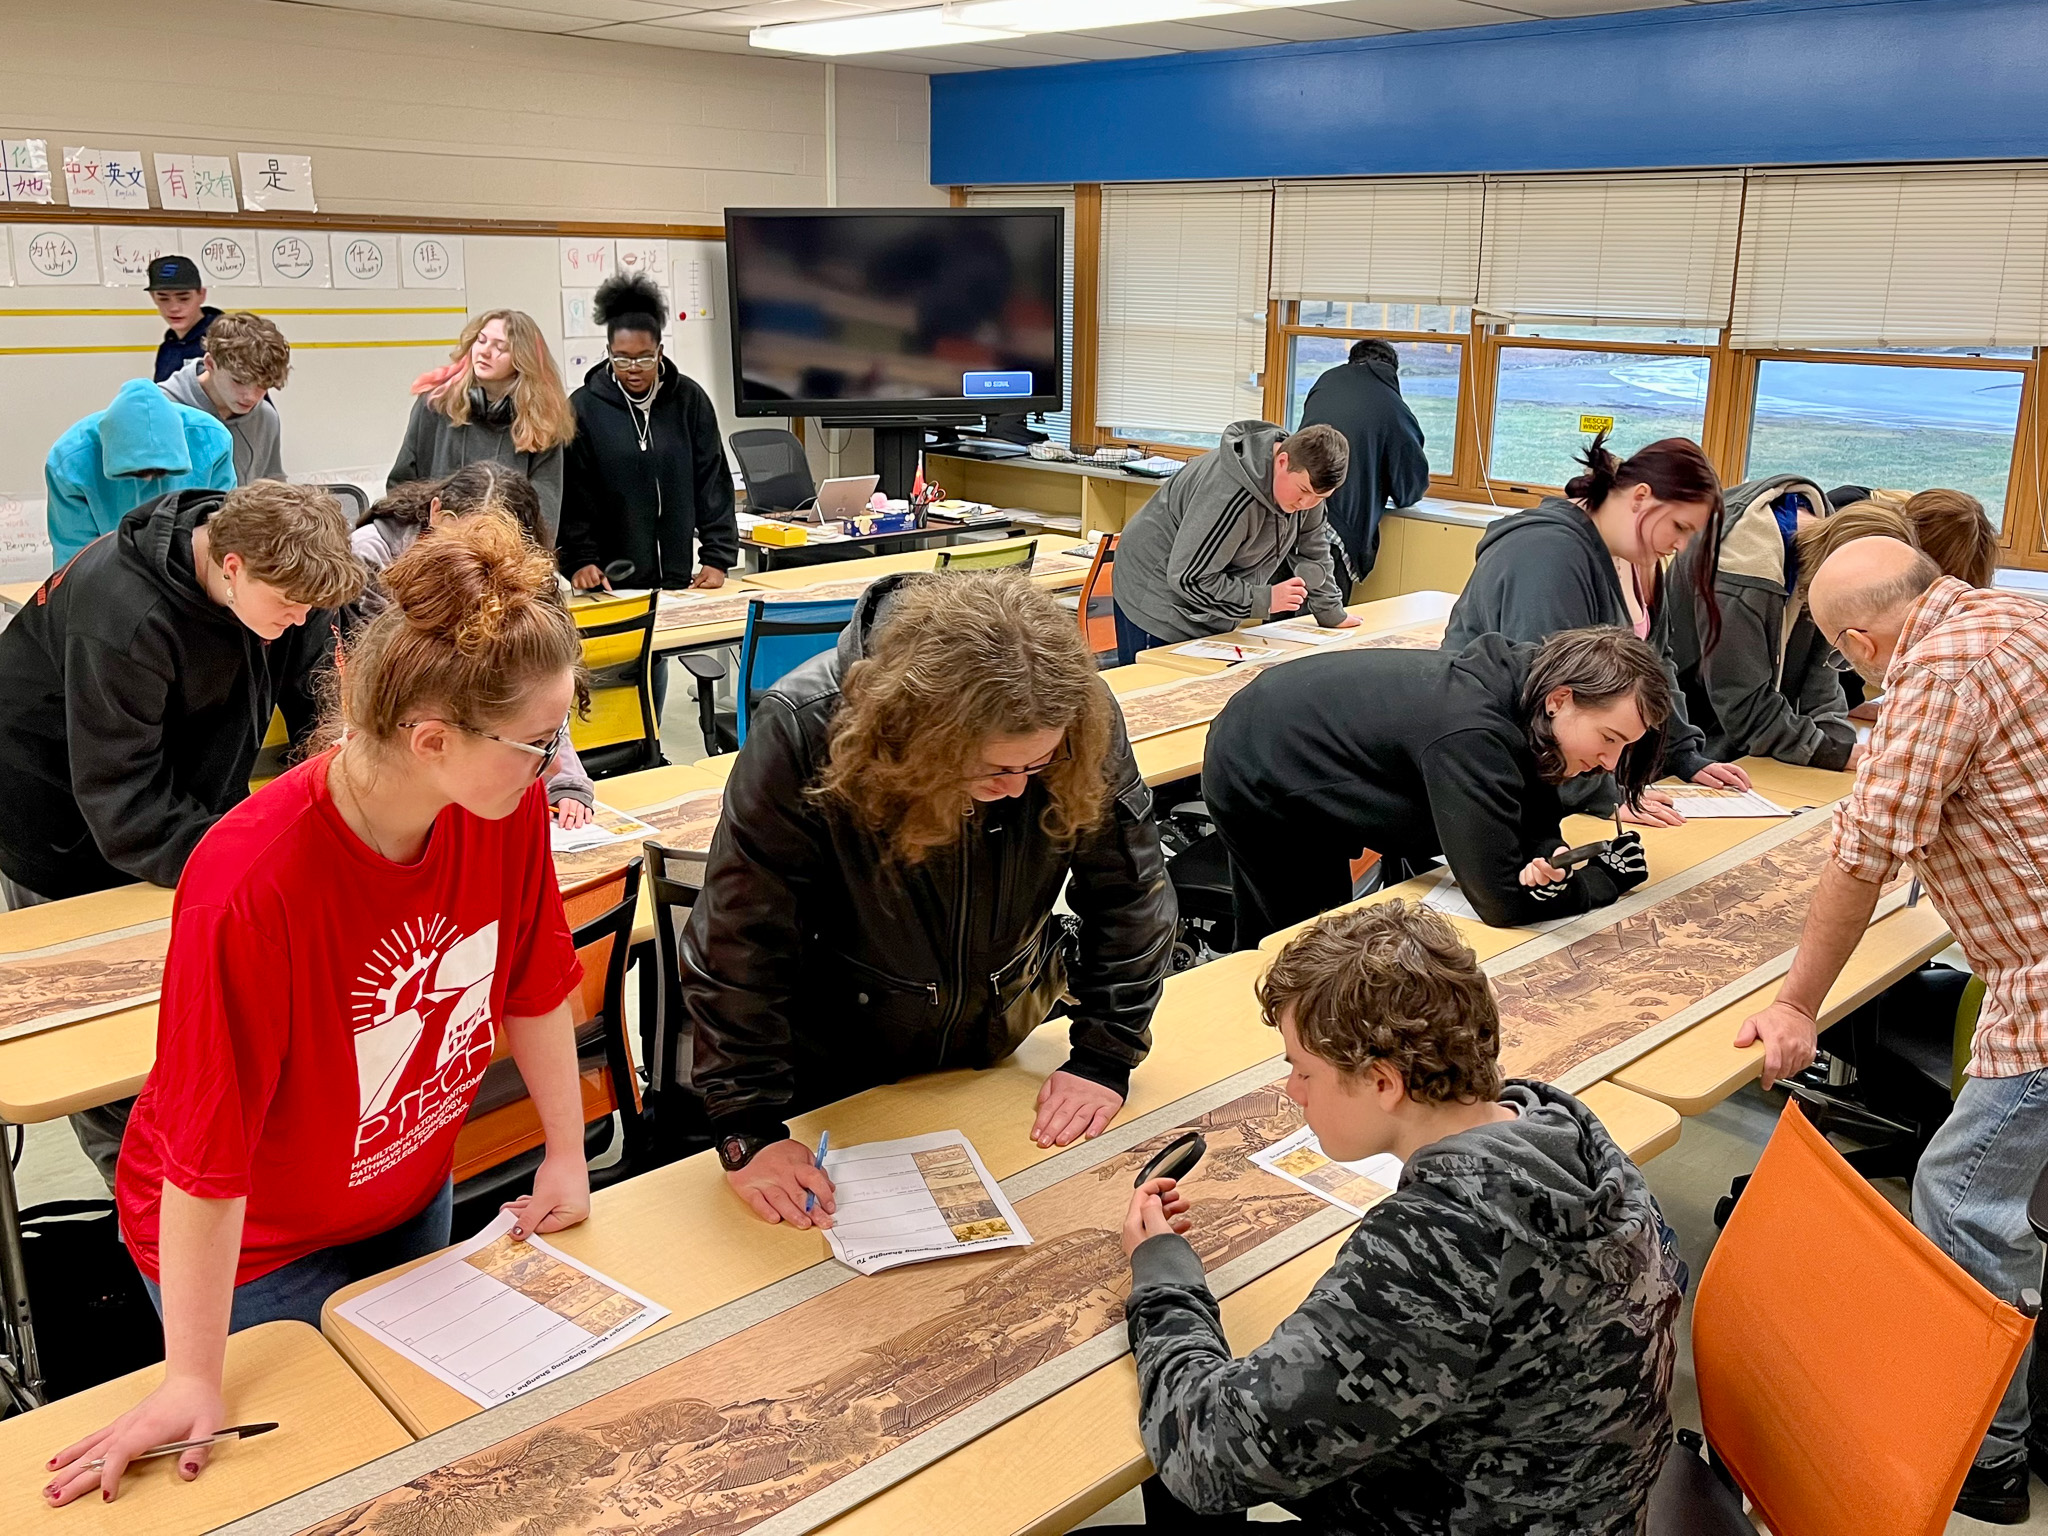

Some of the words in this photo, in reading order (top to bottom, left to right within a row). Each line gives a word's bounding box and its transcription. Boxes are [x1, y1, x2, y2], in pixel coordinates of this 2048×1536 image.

[13, 175, 49, 196] 她
[104, 162, 145, 188] 英文
[161, 162, 188, 199] 有
[195, 171, 234, 199] 没有
[259, 159, 296, 193] 是
[204, 243, 241, 263] 哪里
[349, 244, 380, 262] 什么
[354, 1022, 495, 1157] PTECH
[348, 1169, 381, 1188] EARLY
[381, 1143, 420, 1173] COLLEGE
[438, 1102, 470, 1128] SCHOOL
[349, 1146, 402, 1180] PATHWAYS
[402, 1141, 412, 1150] IN
[856, 1257, 867, 1265] Tu
[609, 1313, 647, 1337] Scavenger
[550, 1349, 587, 1370] Qingming
[517, 1369, 551, 1391] Shanghe
[505, 1391, 517, 1399] Tu
